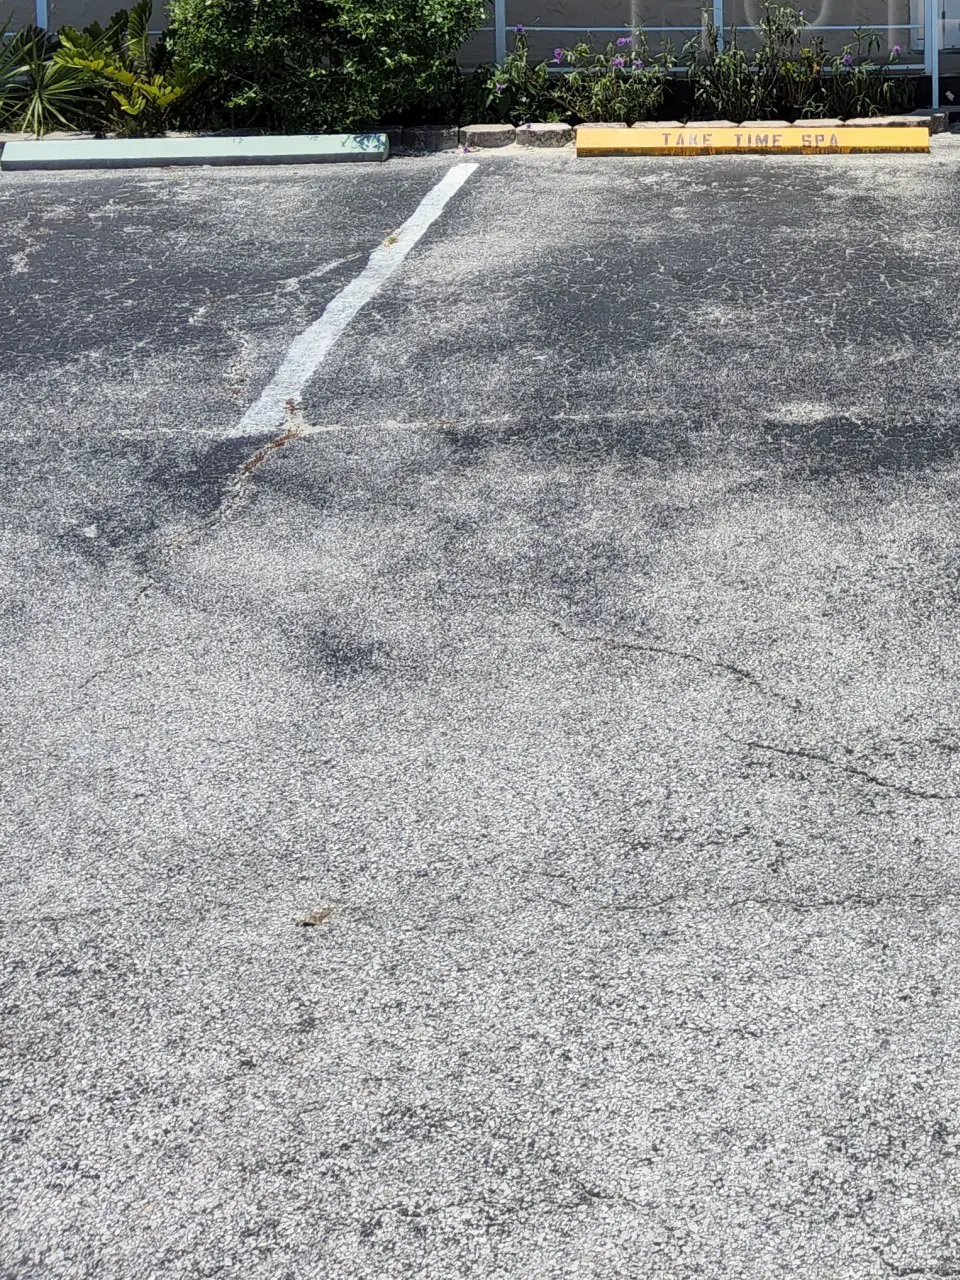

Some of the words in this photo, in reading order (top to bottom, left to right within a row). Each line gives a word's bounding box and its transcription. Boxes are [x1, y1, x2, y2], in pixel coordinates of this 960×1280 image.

[662, 132, 713, 147] TAKE
[733, 133, 783, 148] TIME
[801, 133, 839, 148] SPA
